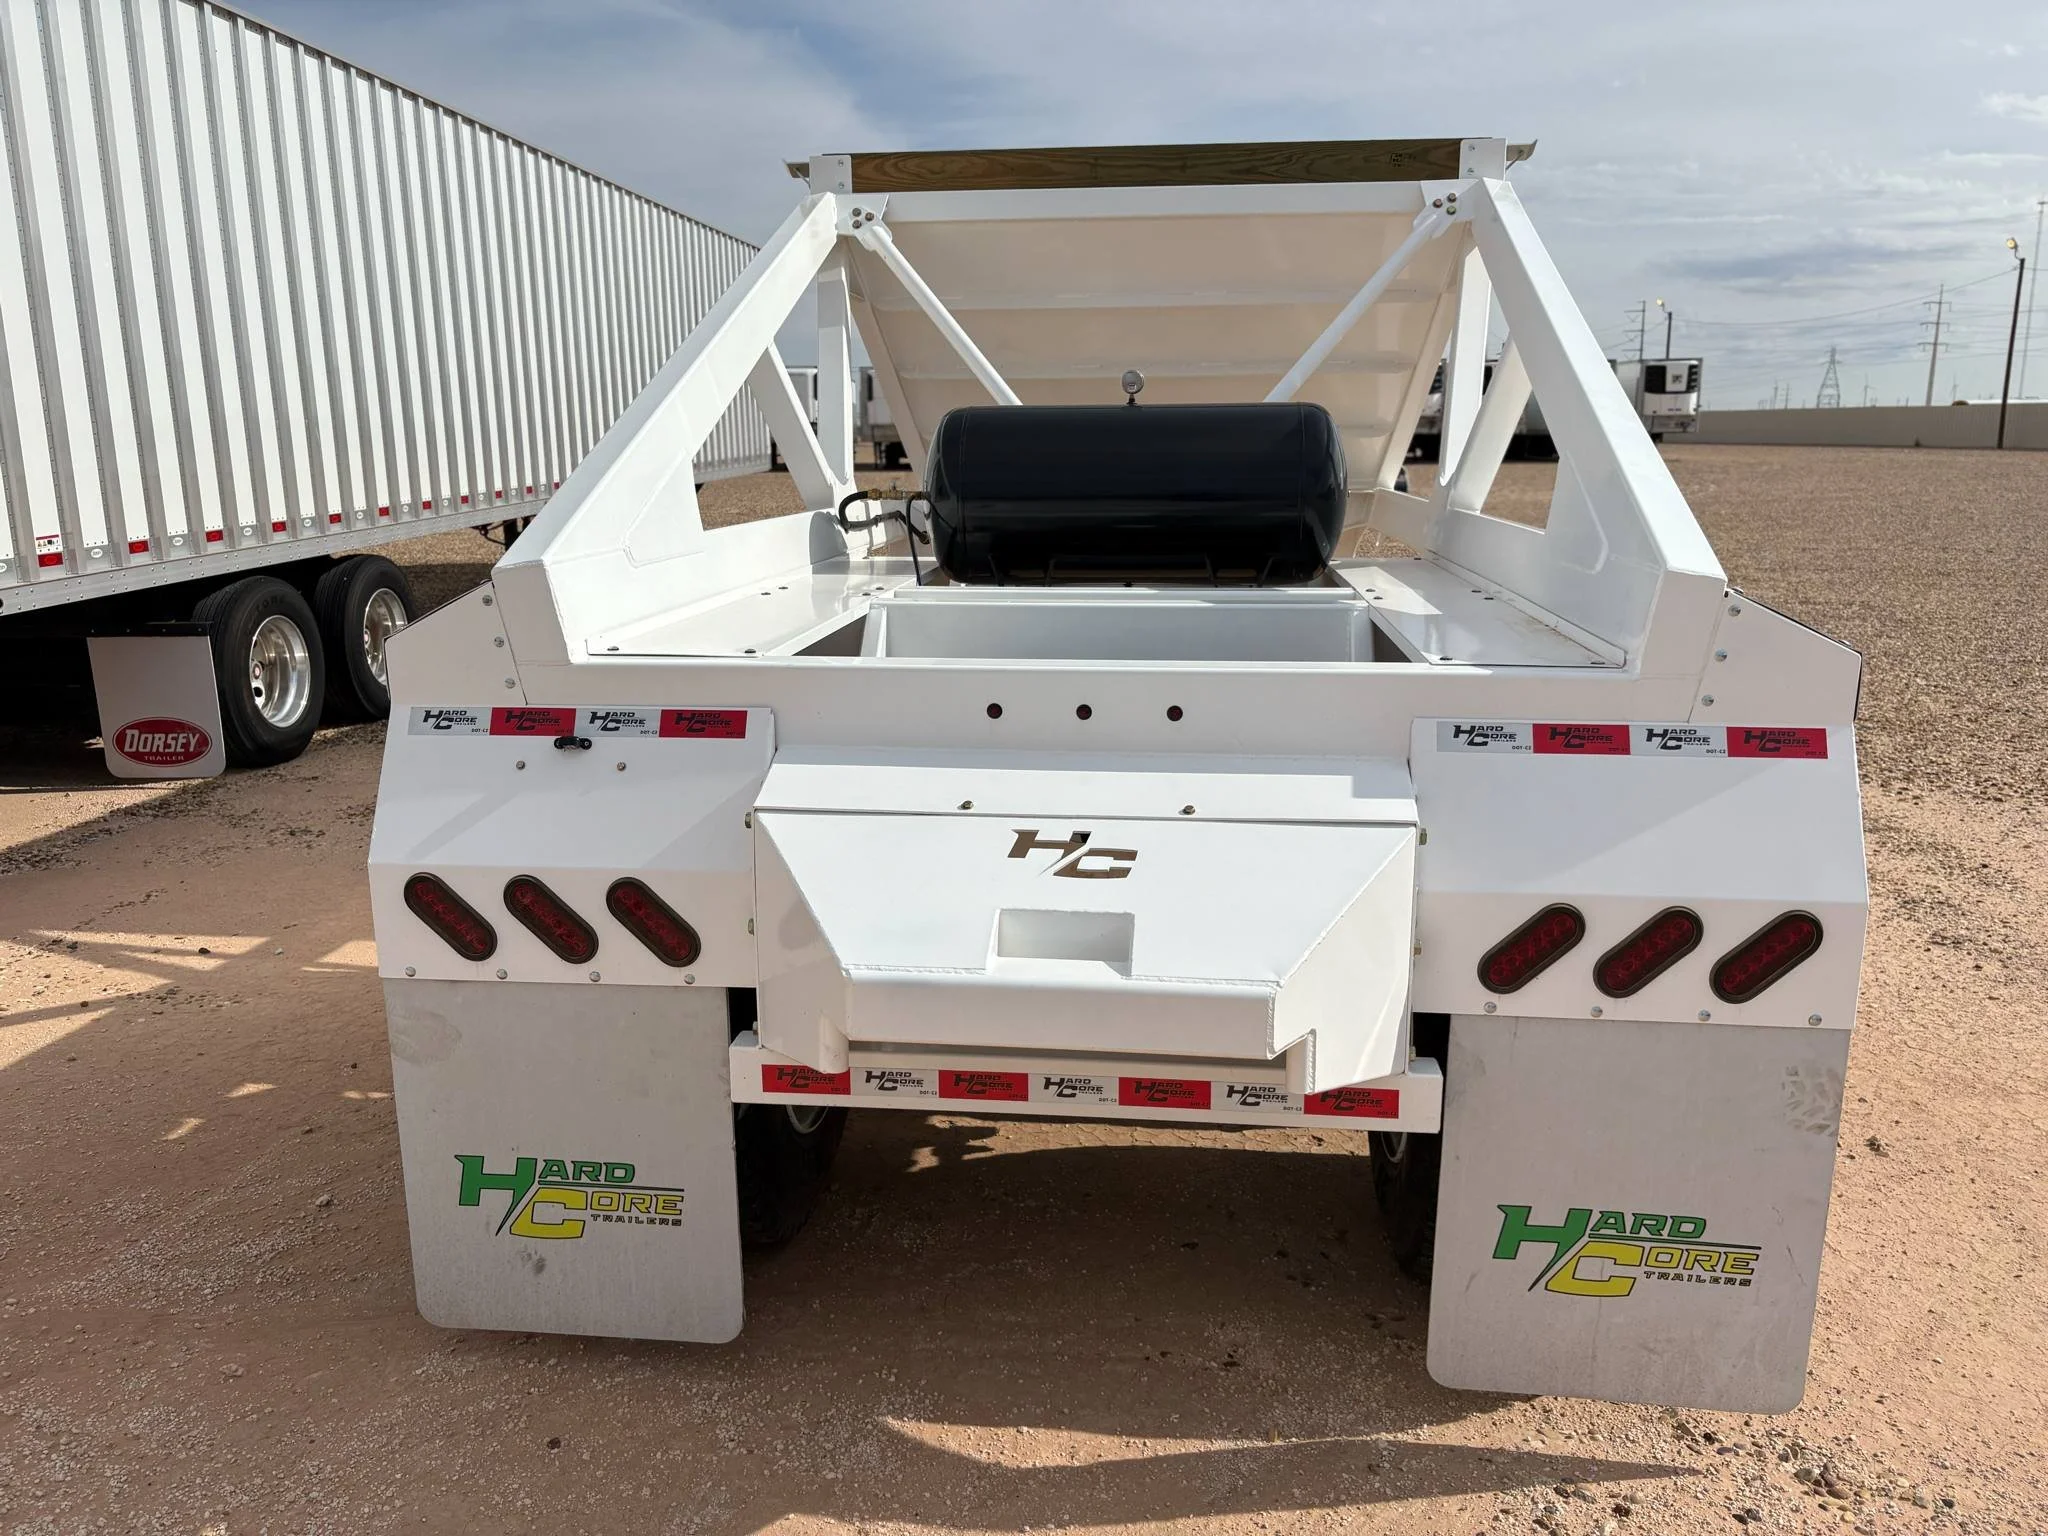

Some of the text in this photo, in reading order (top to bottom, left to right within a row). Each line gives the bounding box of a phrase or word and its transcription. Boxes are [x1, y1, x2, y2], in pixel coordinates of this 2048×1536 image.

[423, 710, 467, 728] HARD
[433, 717, 477, 729] CORE
[505, 710, 551, 728] HARD
[589, 712, 635, 730] HARD
[600, 719, 646, 732] CORE
[675, 713, 720, 731] HARD
[124, 729, 199, 753] DORSEY
[1453, 725, 1504, 745] HARD
[1467, 733, 1517, 746] CORE
[1549, 727, 1600, 746] HARD
[1646, 729, 1697, 749] HARD
[1660, 736, 1711, 750] CORE
[1744, 730, 1796, 749] HARD
[865, 1071, 911, 1090] HARD
[878, 1078, 924, 1091] CORE
[954, 1074, 1001, 1091] HARD
[1044, 1077, 1091, 1096] HARD
[1135, 1081, 1183, 1098] HARD
[1056, 1085, 1104, 1098] CORE
[1227, 1085, 1276, 1104] HARD
[1240, 1093, 1288, 1106] CORE
[454, 1154, 636, 1236] HARD
[510, 1187, 685, 1239] CORE
[591, 1214, 682, 1227] TRAILERS
[1492, 1204, 1707, 1291] HARD
[1544, 1240, 1760, 1297] CORE
[1643, 1270, 1752, 1287] TRAILERS
